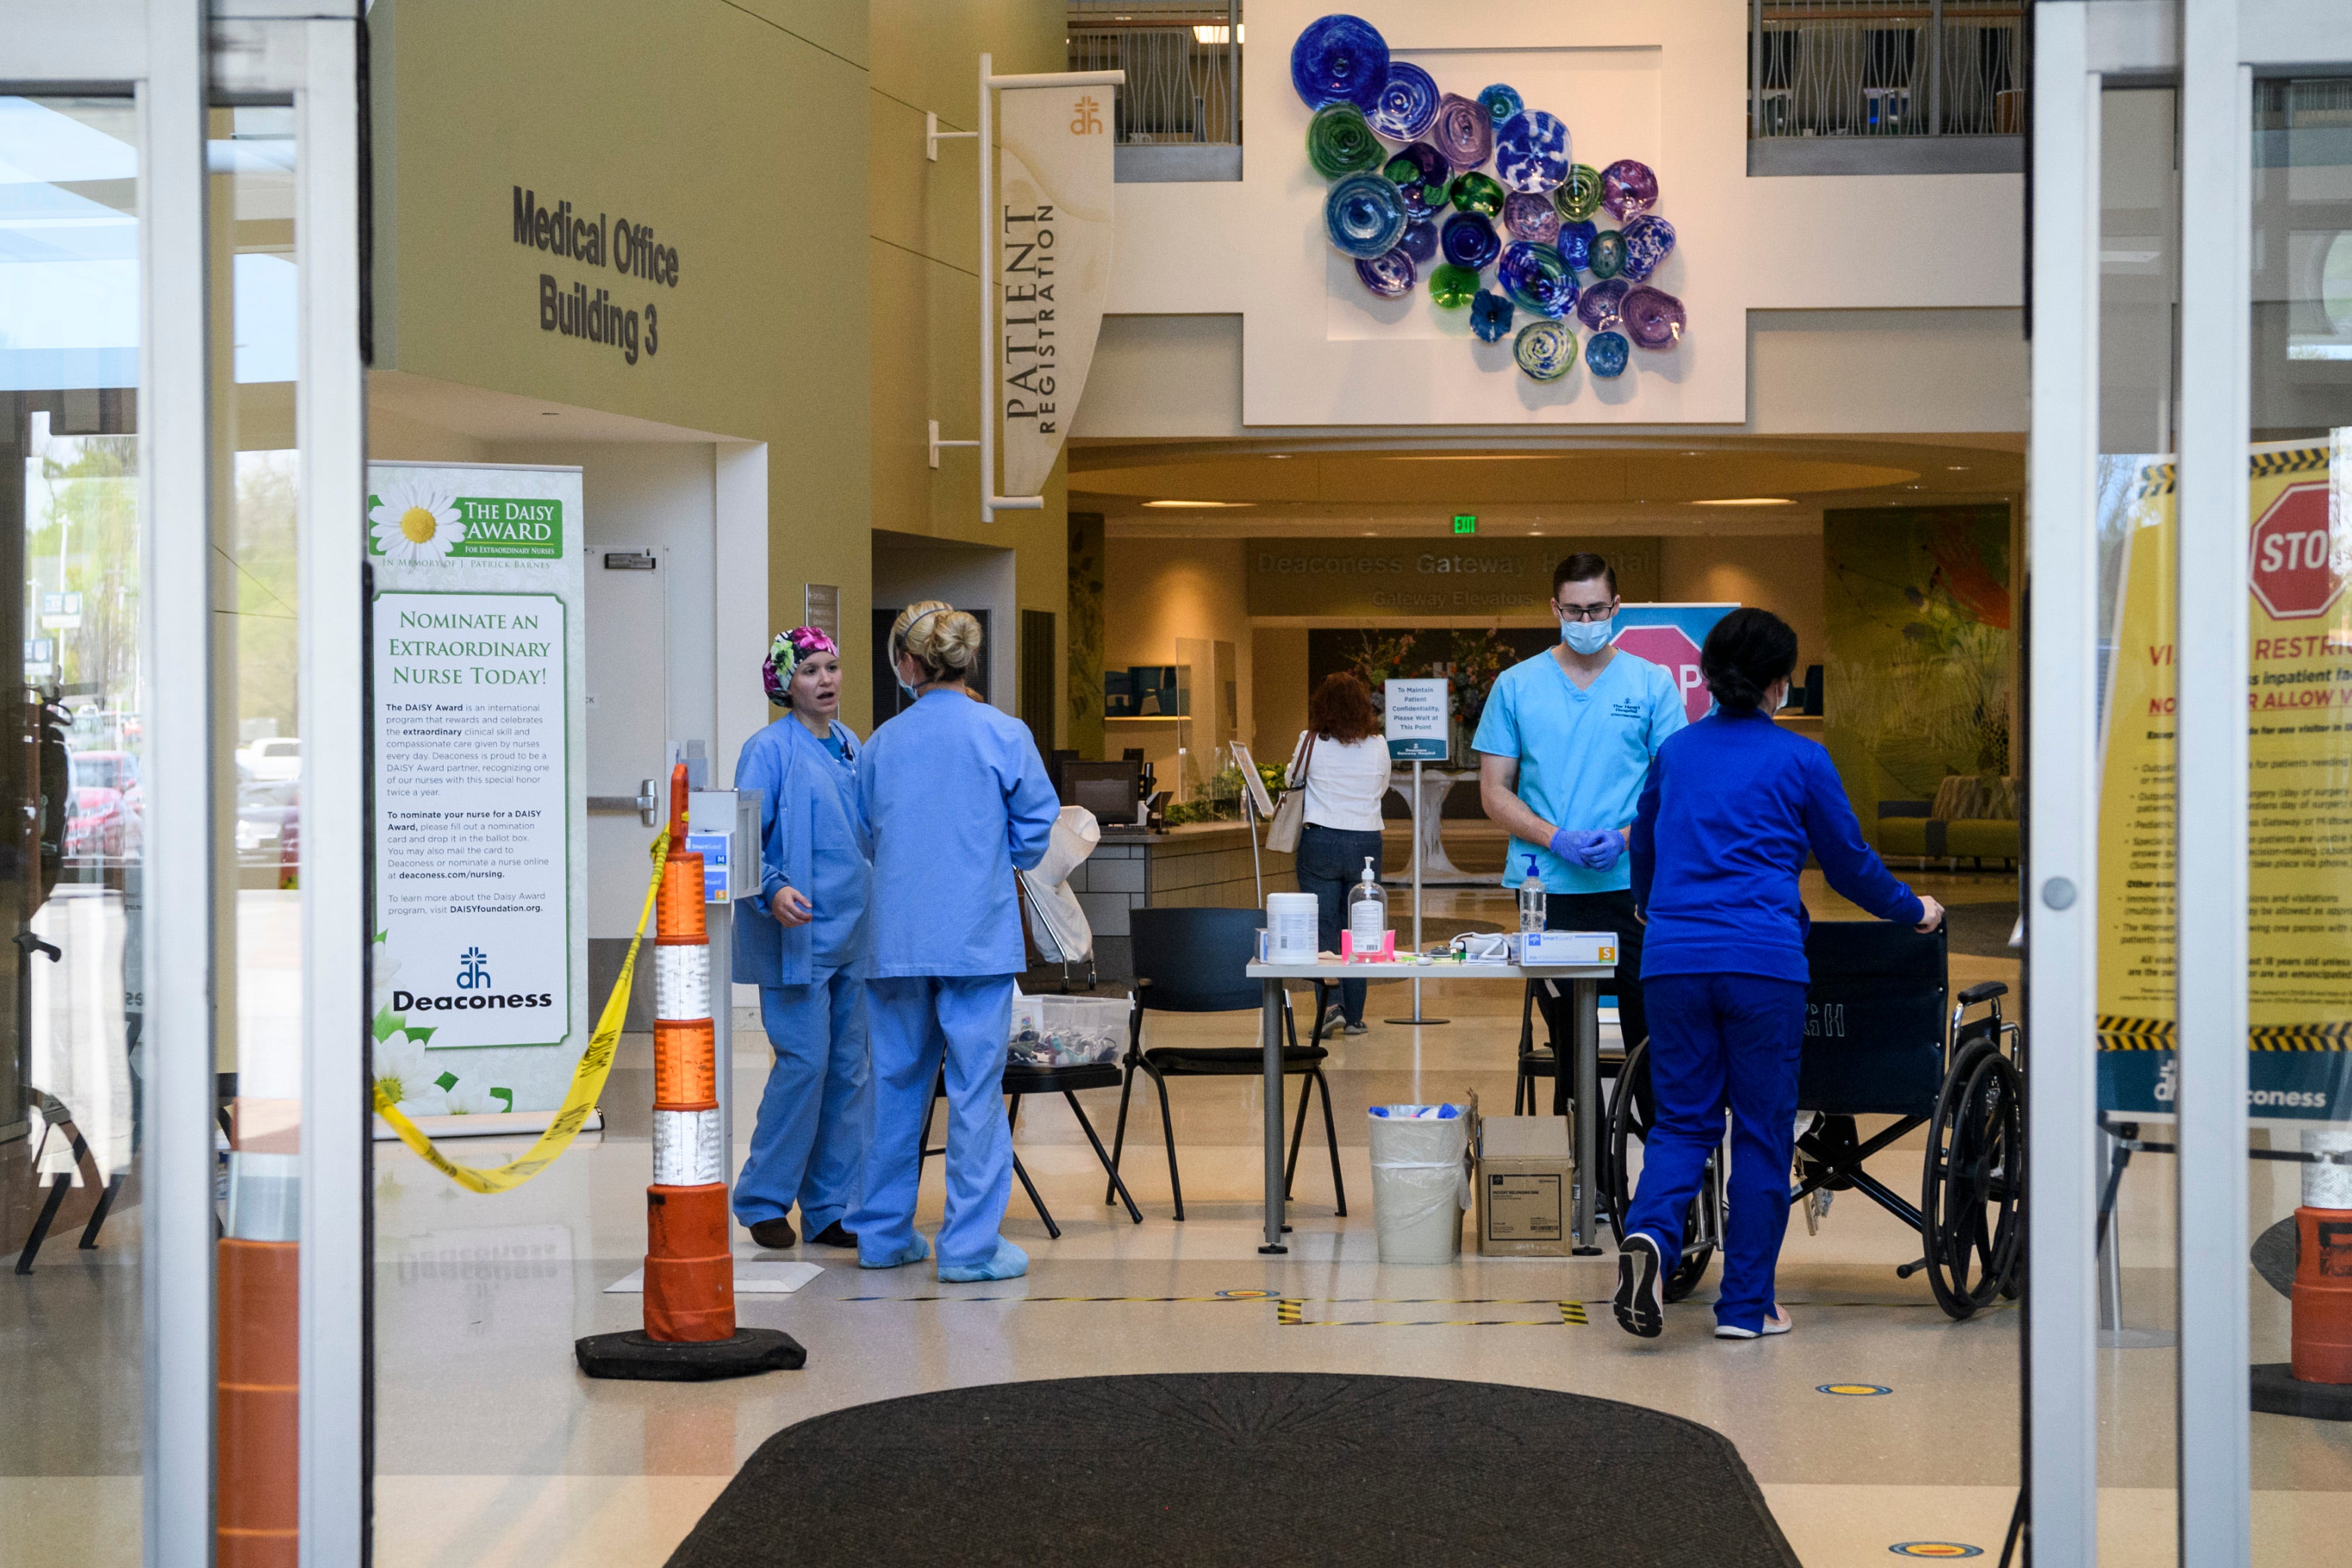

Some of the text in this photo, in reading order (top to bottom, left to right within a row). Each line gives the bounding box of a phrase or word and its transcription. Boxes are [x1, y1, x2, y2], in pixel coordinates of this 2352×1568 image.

[514, 185, 679, 288] Medical Office
[540, 274, 657, 365] Building 3
[1004, 205, 1038, 422] PATIENT
[1037, 205, 1055, 433] REGISTRATION
[465, 502, 554, 520] THE DAISY
[467, 523, 551, 540] AWARD
[1454, 516, 1476, 533] EXIT
[480, 546, 529, 554] EXTRAORDINARY
[2261, 530, 2327, 573] STO
[515, 560, 550, 568] BARNES
[1417, 554, 1525, 577] Gateway
[1542, 552, 1651, 573] Hital
[1373, 590, 1533, 608] Gateway Elevators
[400, 611, 539, 629] NOMINATE AN
[389, 639, 551, 657] EXTRAORDINARY
[392, 666, 546, 684] NURSE TODAY!
[2263, 670, 2331, 688] inpatient
[2264, 689, 2334, 708] ALLOW
[387, 740, 450, 749] compassionate
[475, 740, 497, 749] given
[501, 740, 510, 749] by
[447, 764, 480, 773] partner,
[494, 893, 516, 901] Daisy
[1603, 948, 1611, 959] S
[393, 991, 552, 1012] Deaconess
[2247, 1090, 2326, 1108] oness
